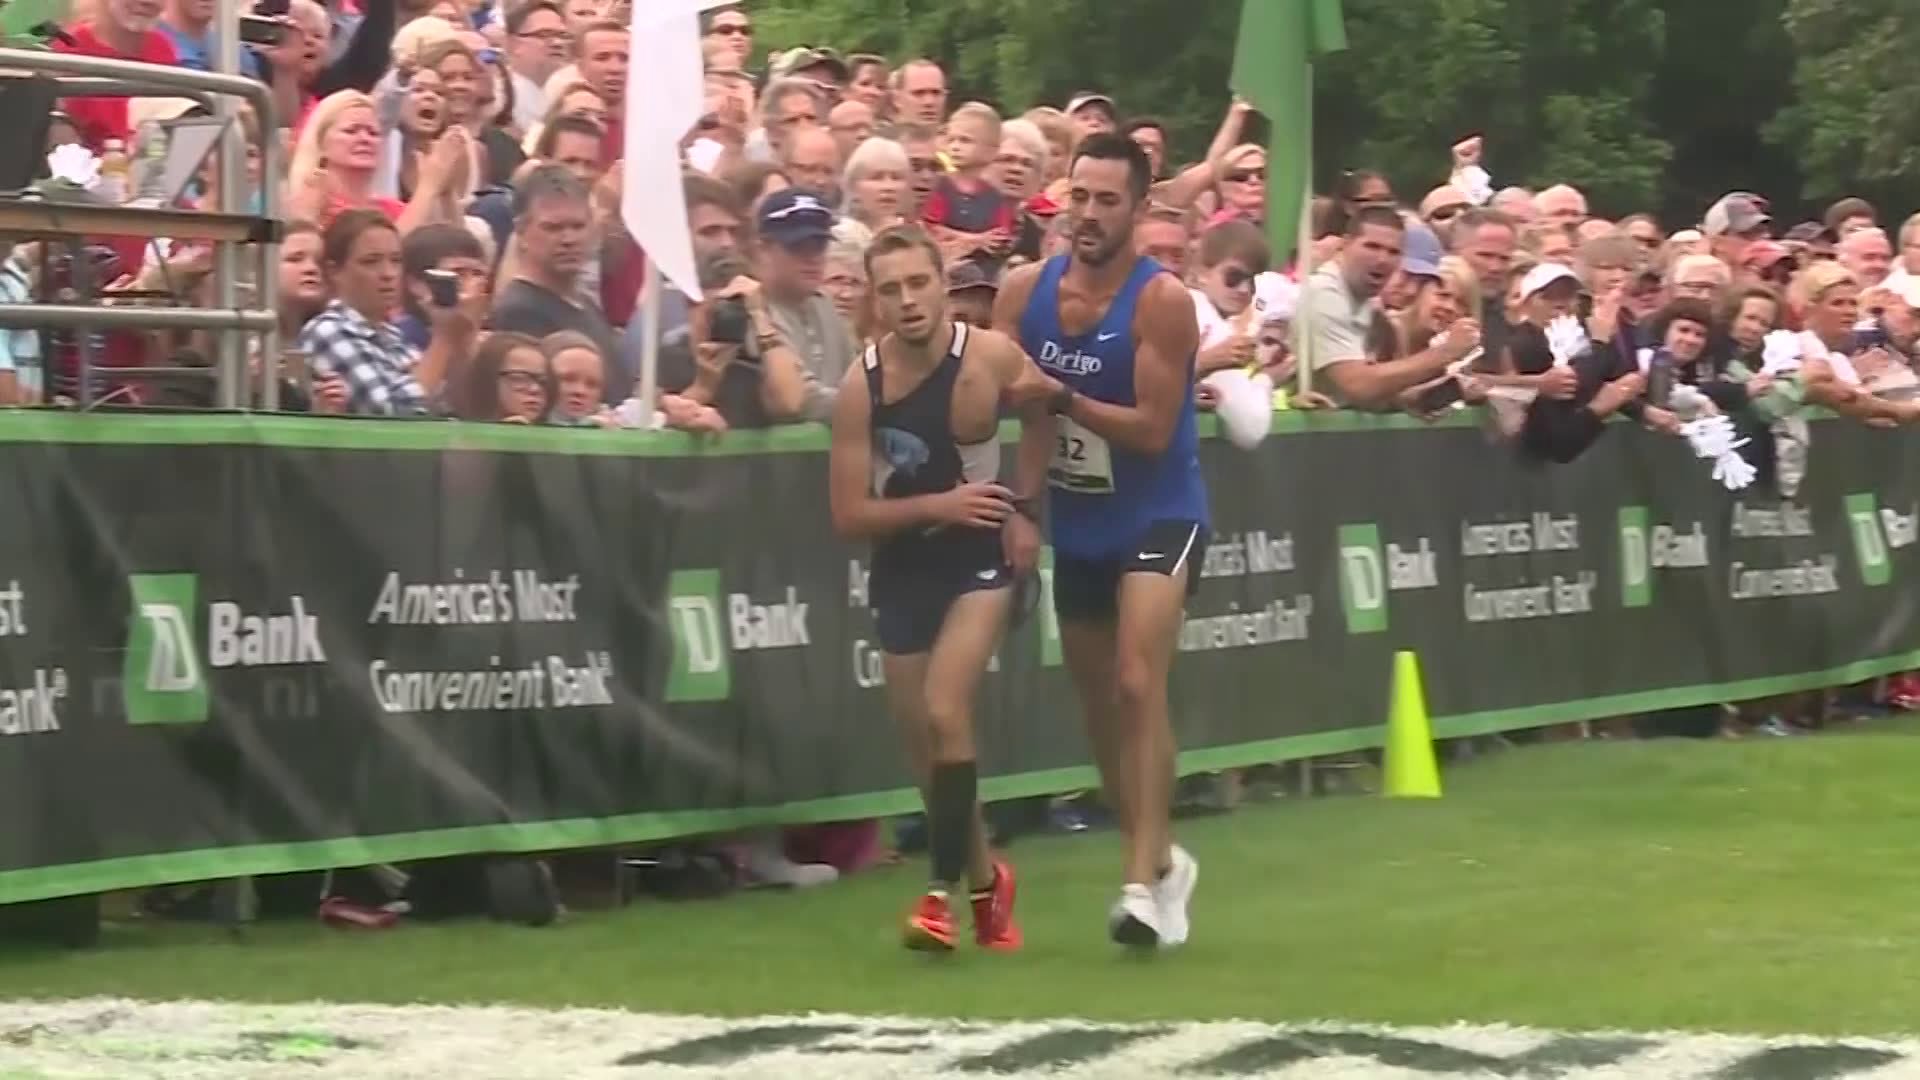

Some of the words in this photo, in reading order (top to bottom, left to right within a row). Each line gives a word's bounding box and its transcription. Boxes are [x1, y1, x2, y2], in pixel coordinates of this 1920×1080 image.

[1040, 340, 1103, 376] Dirigo
[1385, 536, 1438, 590] Bank
[1651, 521, 1709, 568] Bank
[367, 567, 514, 625] America's
[512, 568, 581, 623] Most
[727, 585, 811, 650] Bank
[208, 595, 327, 667] Bank
[368, 654, 546, 712] Convenient
